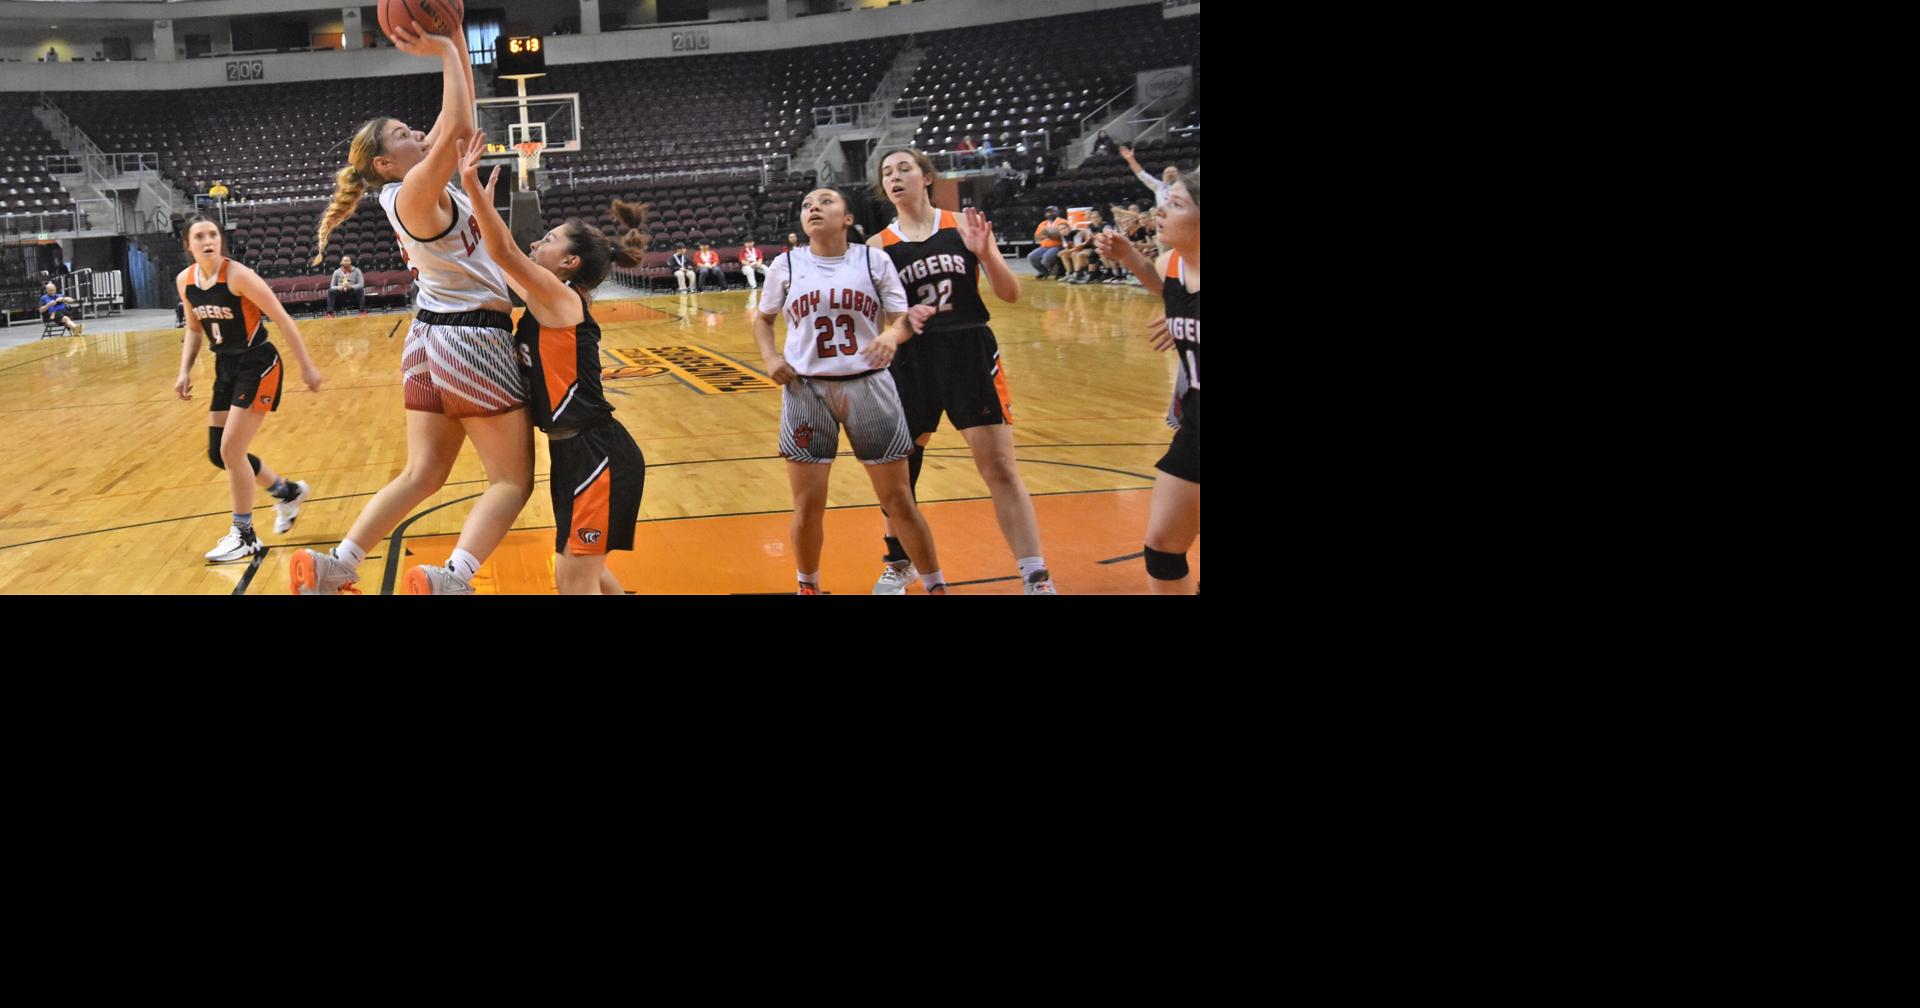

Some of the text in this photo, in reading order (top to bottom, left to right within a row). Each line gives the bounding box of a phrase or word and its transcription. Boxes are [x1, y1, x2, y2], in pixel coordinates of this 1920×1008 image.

[510, 38, 539, 53] 6:13
[672, 32, 709, 50] 210
[227, 62, 263, 80] 209
[460, 214, 482, 258] LA
[899, 253, 966, 286] TIGERS
[916, 277, 953, 313] 22
[211, 322, 224, 345] 4
[814, 314, 859, 359] 23
[1167, 316, 1200, 345] IGE
